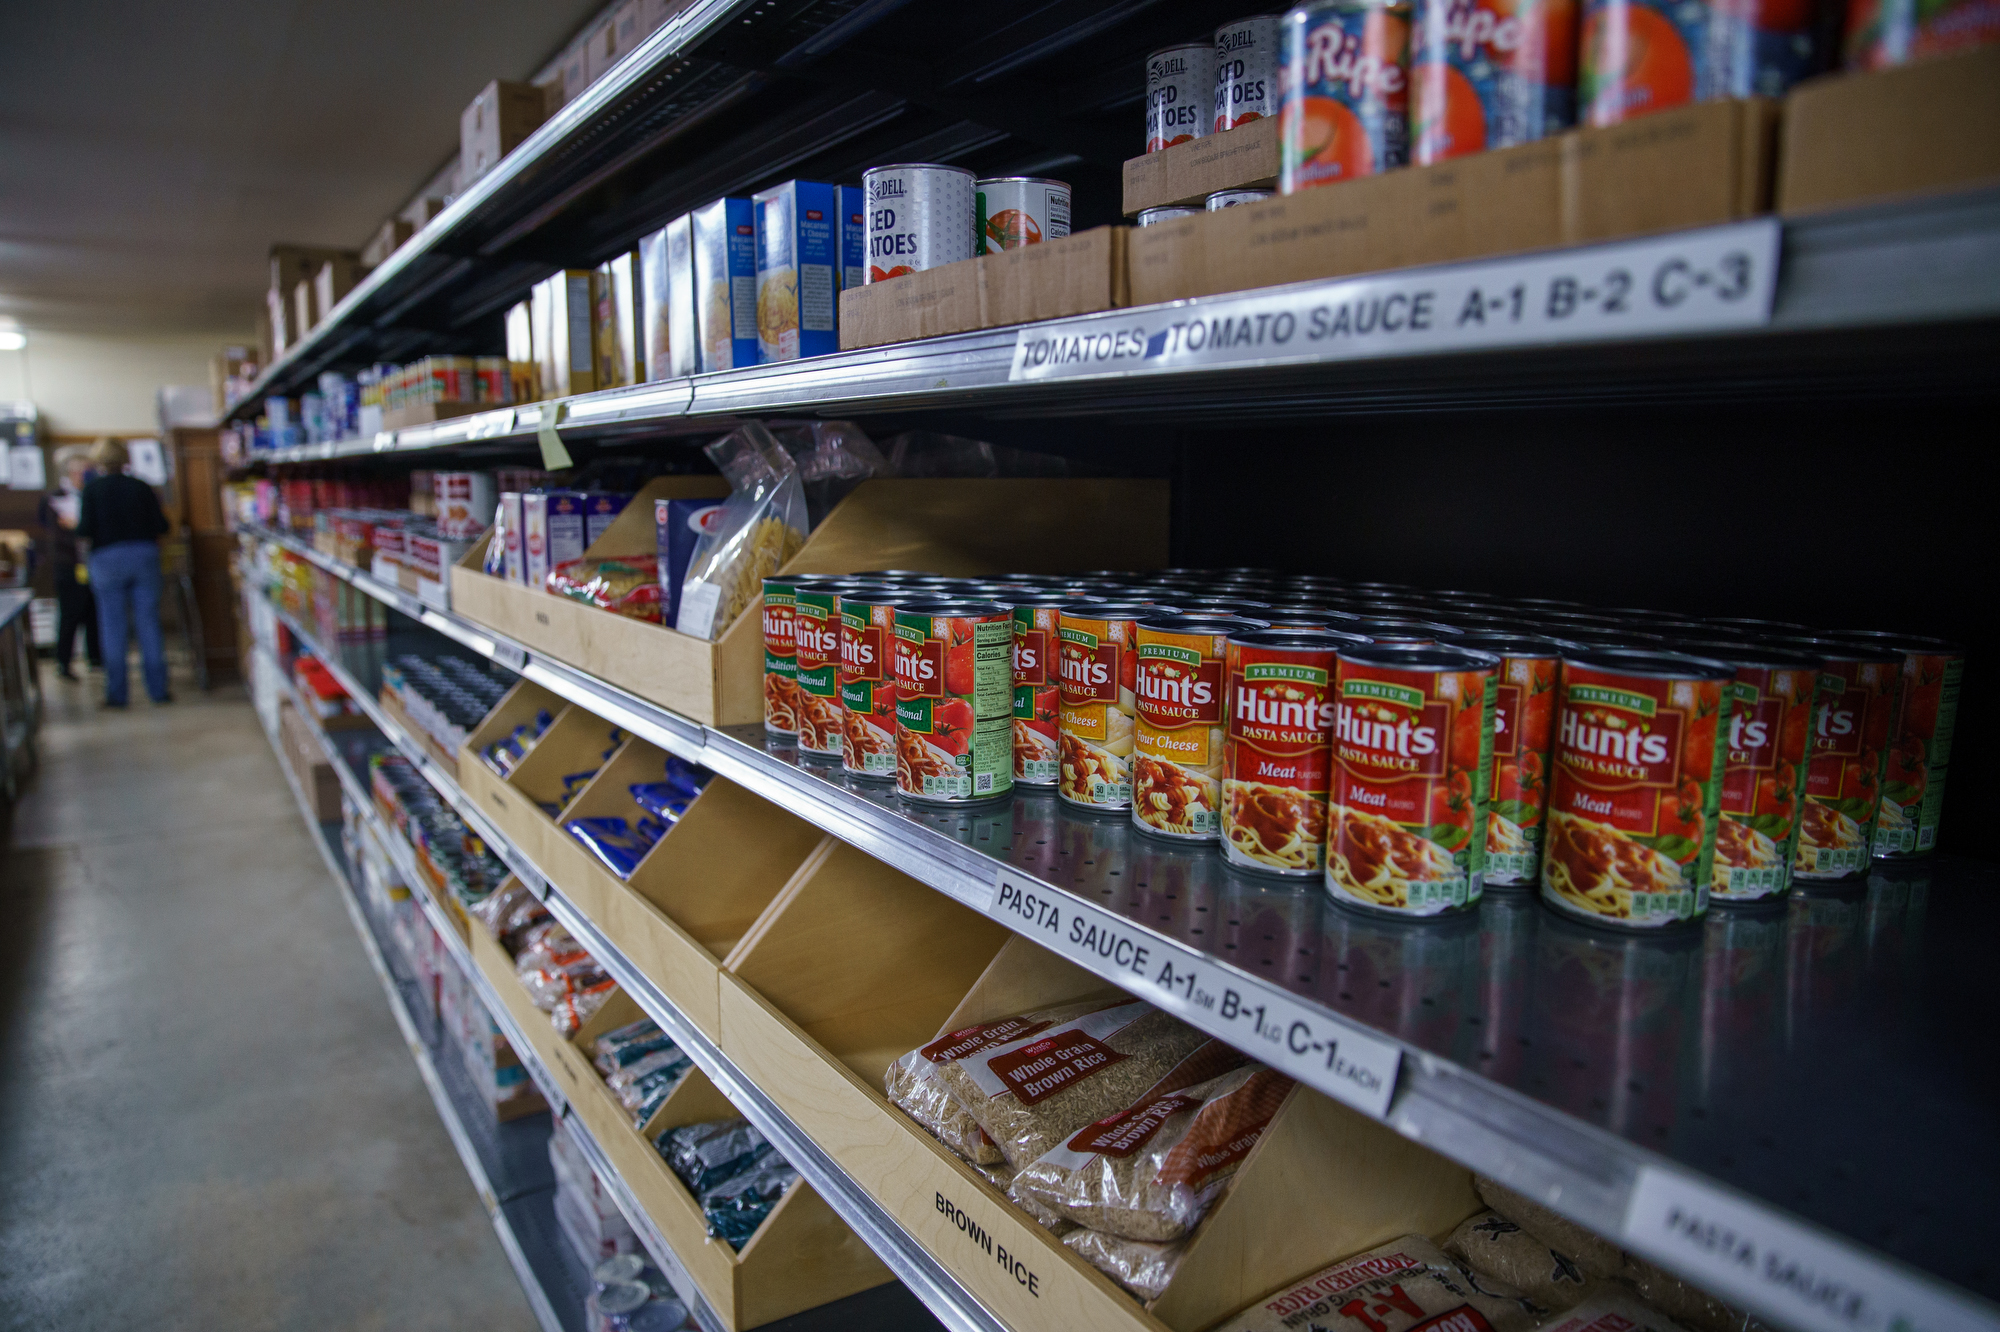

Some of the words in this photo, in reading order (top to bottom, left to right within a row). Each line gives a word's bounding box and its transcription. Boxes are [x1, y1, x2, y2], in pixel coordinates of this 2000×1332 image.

[1232, 30, 1253, 48] DELL
[1165, 57, 1184, 74] DELL
[1306, 23, 1405, 97] Ripe
[882, 178, 904, 197] DELL
[1022, 327, 1147, 368] TOMATOES
[1168, 310, 1297, 354] TOMATO
[1307, 291, 1437, 341] SAUCE
[1456, 282, 1525, 327] A-1
[1545, 267, 1635, 319] B-2
[1651, 250, 1753, 310] C-3
[804, 651, 828, 662] SAUCE
[977, 650, 1001, 660] Calories
[1143, 647, 1190, 660] PREMIUM
[1254, 668, 1316, 681] PREMIUM
[900, 680, 925, 692] SAUCE
[1068, 684, 1098, 698] SAUCE
[1349, 683, 1410, 702] PREMIUM
[1576, 688, 1641, 708] PREMIUM
[1066, 711, 1098, 727] Cheese
[1137, 699, 1160, 715] PASTA
[1161, 705, 1199, 719] SAUCE
[1137, 729, 1155, 746] Four
[1156, 735, 1199, 752] Cheese
[1242, 725, 1278, 742] PASTA
[1280, 731, 1325, 744] SAUCE
[1339, 744, 1369, 766] PASTA
[1371, 754, 1420, 772] SAUCE
[1563, 750, 1595, 772] PASTA
[1597, 760, 1650, 780] SAUCE
[1257, 761, 1297, 779] Meat
[1096, 785, 1104, 794] 50
[1349, 784, 1387, 808] Meat
[1572, 790, 1613, 816] Meat
[1196, 814, 1205, 823] 50
[998, 883, 1060, 933] PASTA
[1069, 916, 1150, 976] SAUCE
[938, 1034, 985, 1063] Whole
[985, 1018, 1021, 1041] Grain
[1007, 1051, 1056, 1083] Whole
[1056, 1040, 1096, 1062] Grain
[1023, 1064, 1076, 1097] Brown
[1076, 1050, 1108, 1073] Rice
[1091, 1120, 1132, 1149] Whole
[1111, 1116, 1159, 1150] Brown
[1197, 1149, 1231, 1171] Whole
[1228, 1131, 1260, 1153] Grain
[936, 1191, 992, 1256] BROWN
[997, 1244, 1039, 1299] RICE
[1265, 1283, 1322, 1317] RICE
